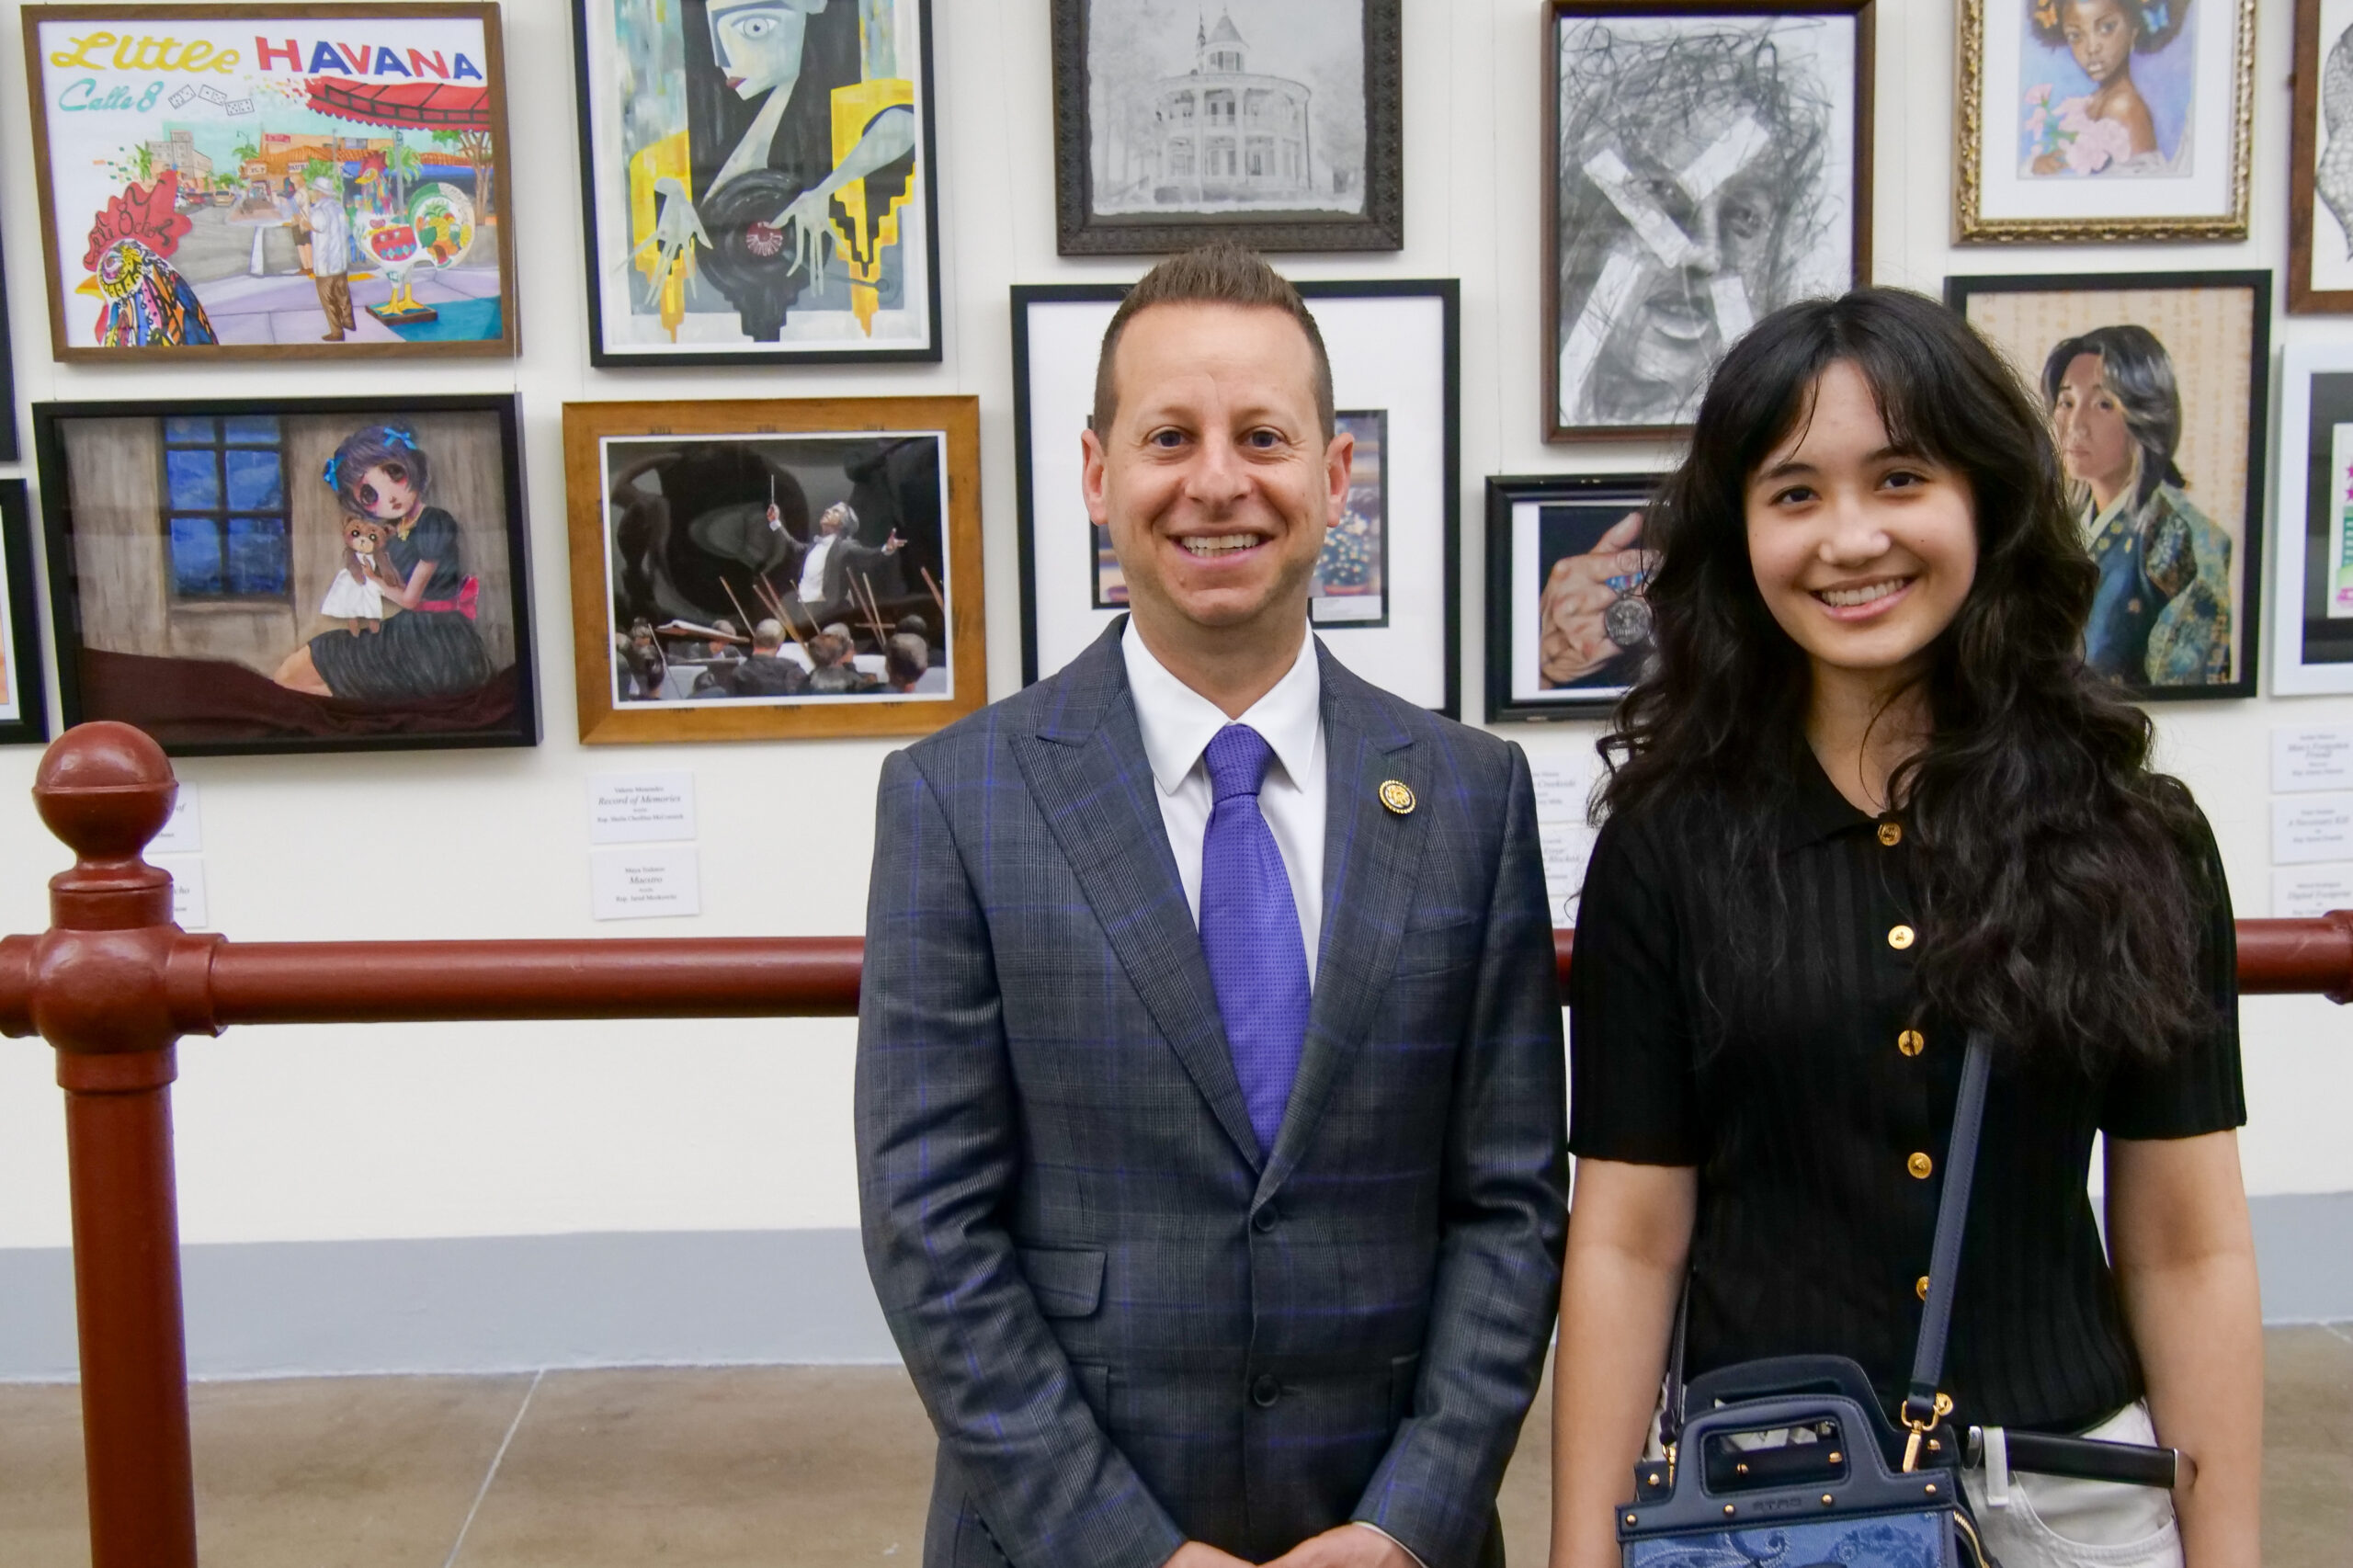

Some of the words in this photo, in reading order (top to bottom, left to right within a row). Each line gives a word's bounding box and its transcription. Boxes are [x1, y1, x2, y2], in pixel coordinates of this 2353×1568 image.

[50, 30, 241, 74] Little
[255, 35, 483, 82] HAVANA
[58, 77, 134, 112] Calle
[136, 80, 165, 112] 8
[598, 795, 629, 805] Record
[630, 794, 639, 805] of
[641, 794, 681, 803] Memories
[630, 876, 663, 884] Maestro
